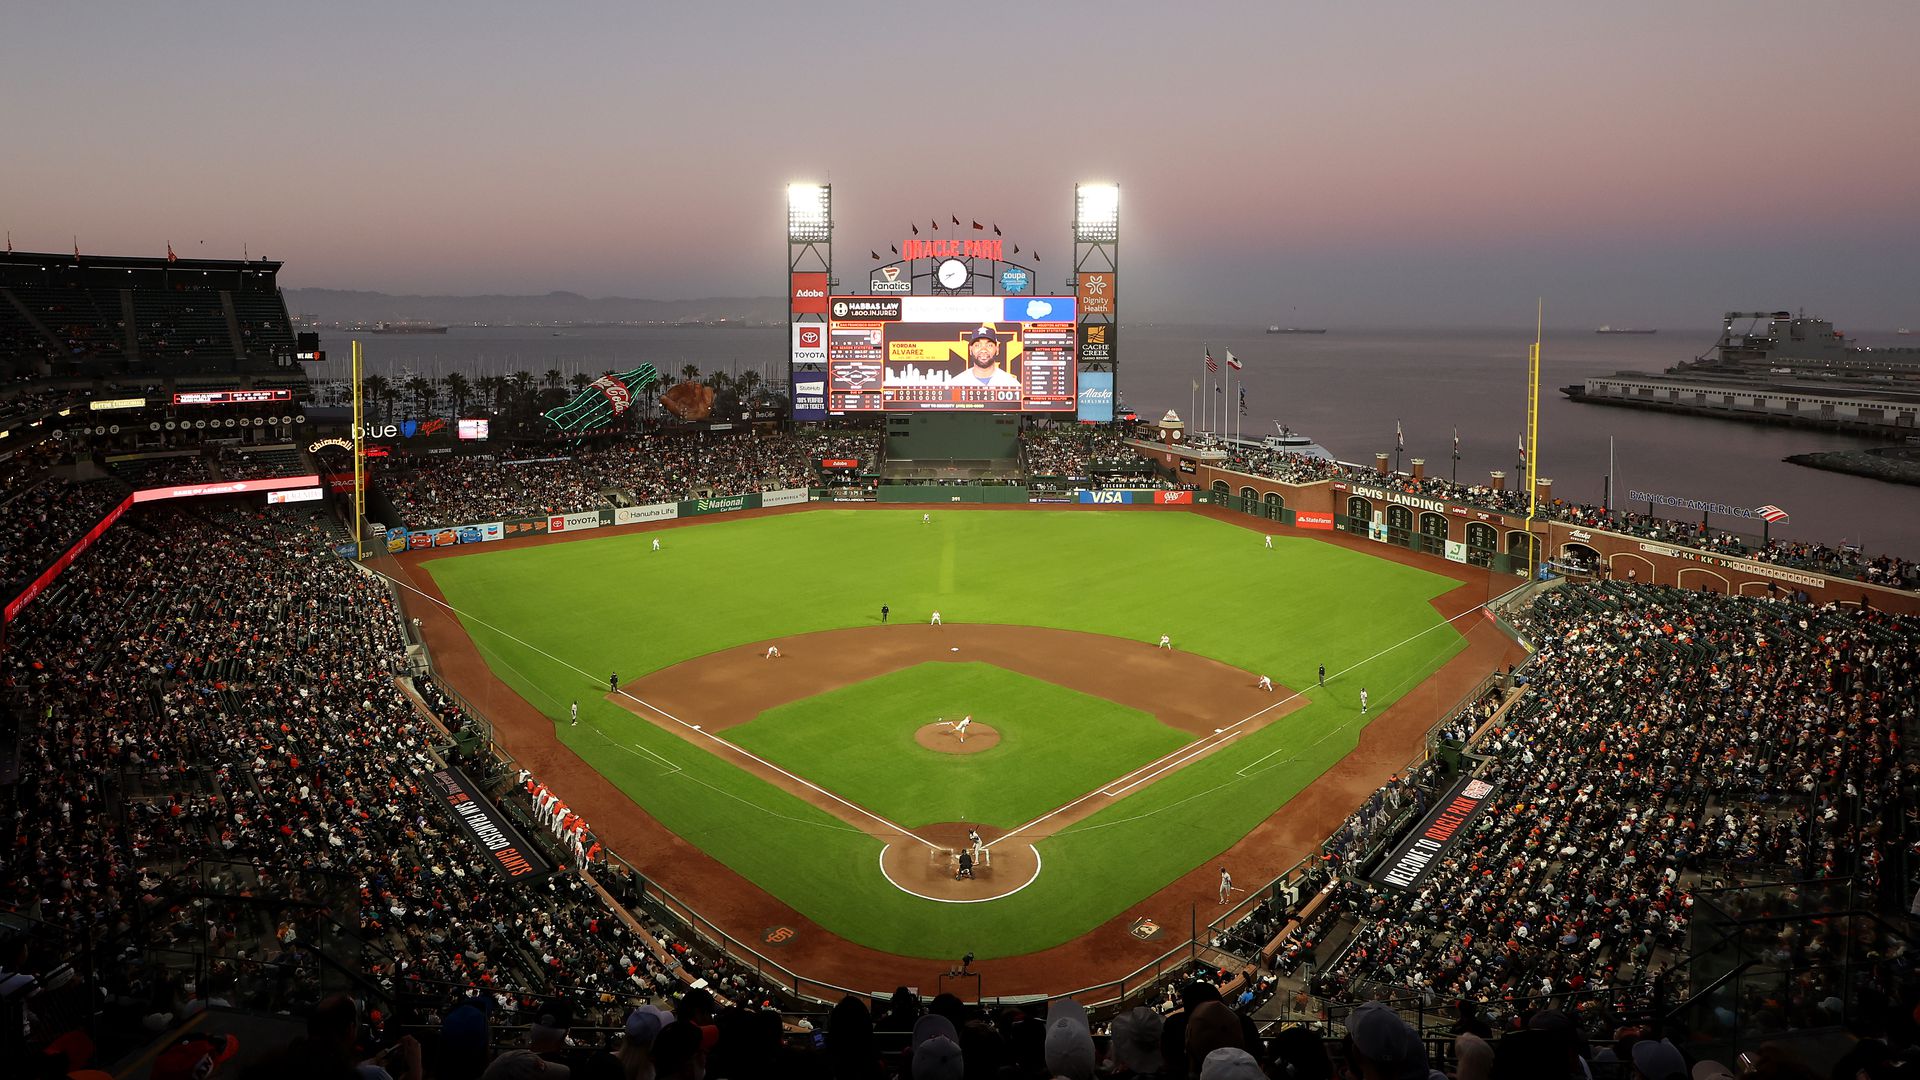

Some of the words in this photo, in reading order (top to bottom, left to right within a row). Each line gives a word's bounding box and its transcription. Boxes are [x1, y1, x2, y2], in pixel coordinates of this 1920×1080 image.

[903, 240, 960, 261] ORACLE
[964, 240, 1003, 261] PARK
[872, 281, 910, 290] Fanatics
[796, 289, 824, 297] Adobe
[1083, 297, 1108, 305] Dignity
[1079, 388, 1112, 398] Alaska
[308, 437, 354, 453] Ghirardelli
[202, 486, 232, 494] AMERICA
[709, 497, 744, 509] National
[1089, 491, 1123, 503] VISA
[1387, 492, 1444, 513] LANDING
[1629, 490, 1664, 504] BANK
[1667, 497, 1682, 507] OF
[1687, 500, 1751, 519] AMERICA
[630, 510, 660, 518] Hanwha
[567, 516, 597, 525] TOYOTA
[1569, 530, 1592, 540] Alaska
[1516, 569, 1528, 577] 309
[455, 801, 481, 816] SAN
[1446, 796, 1479, 816] PARK
[465, 813, 510, 850] FRANCISCO
[1424, 813, 1464, 841] ORACLE
[1414, 838, 1442, 851] TO
[495, 848, 533, 876] GIANTS
[1383, 848, 1434, 887] WELCOME
